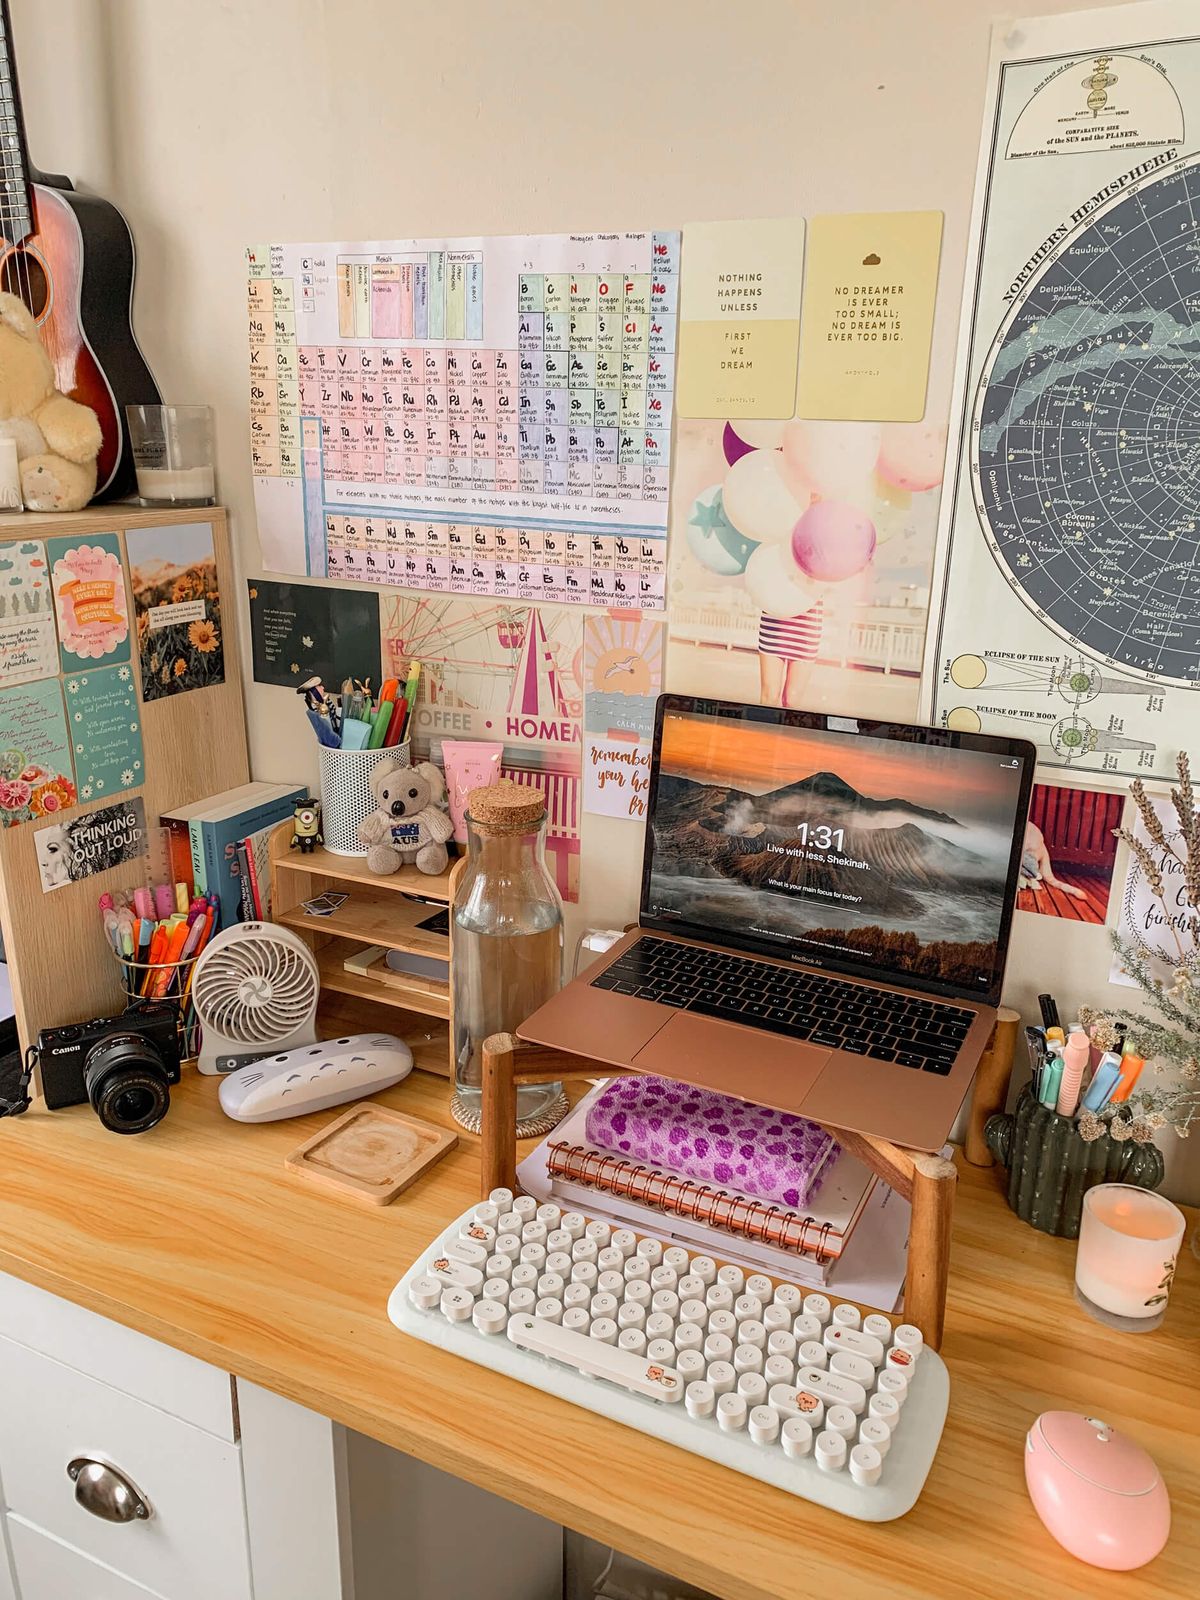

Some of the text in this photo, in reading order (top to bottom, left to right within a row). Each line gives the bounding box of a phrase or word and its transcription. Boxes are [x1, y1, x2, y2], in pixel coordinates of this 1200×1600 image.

[1066, 126, 1104, 134] COMPARATIVE
[1106, 131, 1138, 139] PLANETS.
[1002, 148, 1178, 304] NORTHERN HEMISPHERE
[654, 245, 667, 255] He
[719, 274, 762, 282] NOTHING
[522, 284, 528, 293] B
[548, 284, 554, 294] C
[571, 285, 577, 293] N
[599, 284, 608, 294] O
[625, 284, 634, 294] F
[652, 284, 666, 294] Ne
[718, 288, 762, 297] HAPPENS
[835, 286, 904, 295] NO DREAMER
[1040, 285, 1082, 293] Delphinus
[862, 298, 888, 306] EVER
[721, 303, 758, 312] UNLESS
[836, 310, 899, 318] TOO SMALL;
[249, 322, 263, 331] Na
[519, 323, 529, 333] Al
[571, 323, 576, 333] P
[600, 323, 605, 332] S
[651, 323, 662, 333] Ar
[832, 321, 900, 330] NO DREAM IS
[725, 333, 751, 341] FIRST
[857, 333, 877, 341] TOO
[882, 333, 903, 341] BIG.
[251, 351, 259, 363] K
[277, 355, 287, 365] Ca
[338, 355, 347, 366] V
[362, 358, 372, 368] Cr
[426, 358, 436, 368] Co
[448, 356, 457, 369] Ni
[497, 359, 507, 369] Zn
[597, 361, 607, 371] Se
[623, 362, 634, 371] Br
[649, 361, 660, 372] Kr
[251, 387, 264, 399] Rb
[341, 392, 353, 402] Nb
[403, 394, 414, 405] Ru
[427, 394, 437, 405] Rh
[450, 395, 460, 405] Pd
[472, 397, 483, 407] Ag
[499, 396, 509, 406] Cd
[649, 399, 661, 410] Xe
[404, 428, 414, 439] Os
[473, 431, 486, 440] Au
[645, 438, 657, 448] Rn
[984, 651, 1015, 660] ECLIPSE
[1125, 654, 1164, 670] Virgo
[977, 706, 1006, 714] ECLIPSE
[418, 711, 472, 731] OFFEE
[598, 770, 649, 792] your he
[71, 814, 135, 847] THINKING
[393, 835, 419, 844] AUS
[797, 823, 844, 852] 1:31
[74, 829, 142, 862] OUT LOUD
[766, 844, 871, 870] Live with less, Shekinah.
[768, 878, 785, 888] What
[792, 883, 803, 892] your
[804, 884, 816, 893] main
[817, 887, 834, 896] focus
[842, 893, 862, 903] today?
[792, 954, 815, 964] MacBook
[52, 1045, 80, 1055] Canon
